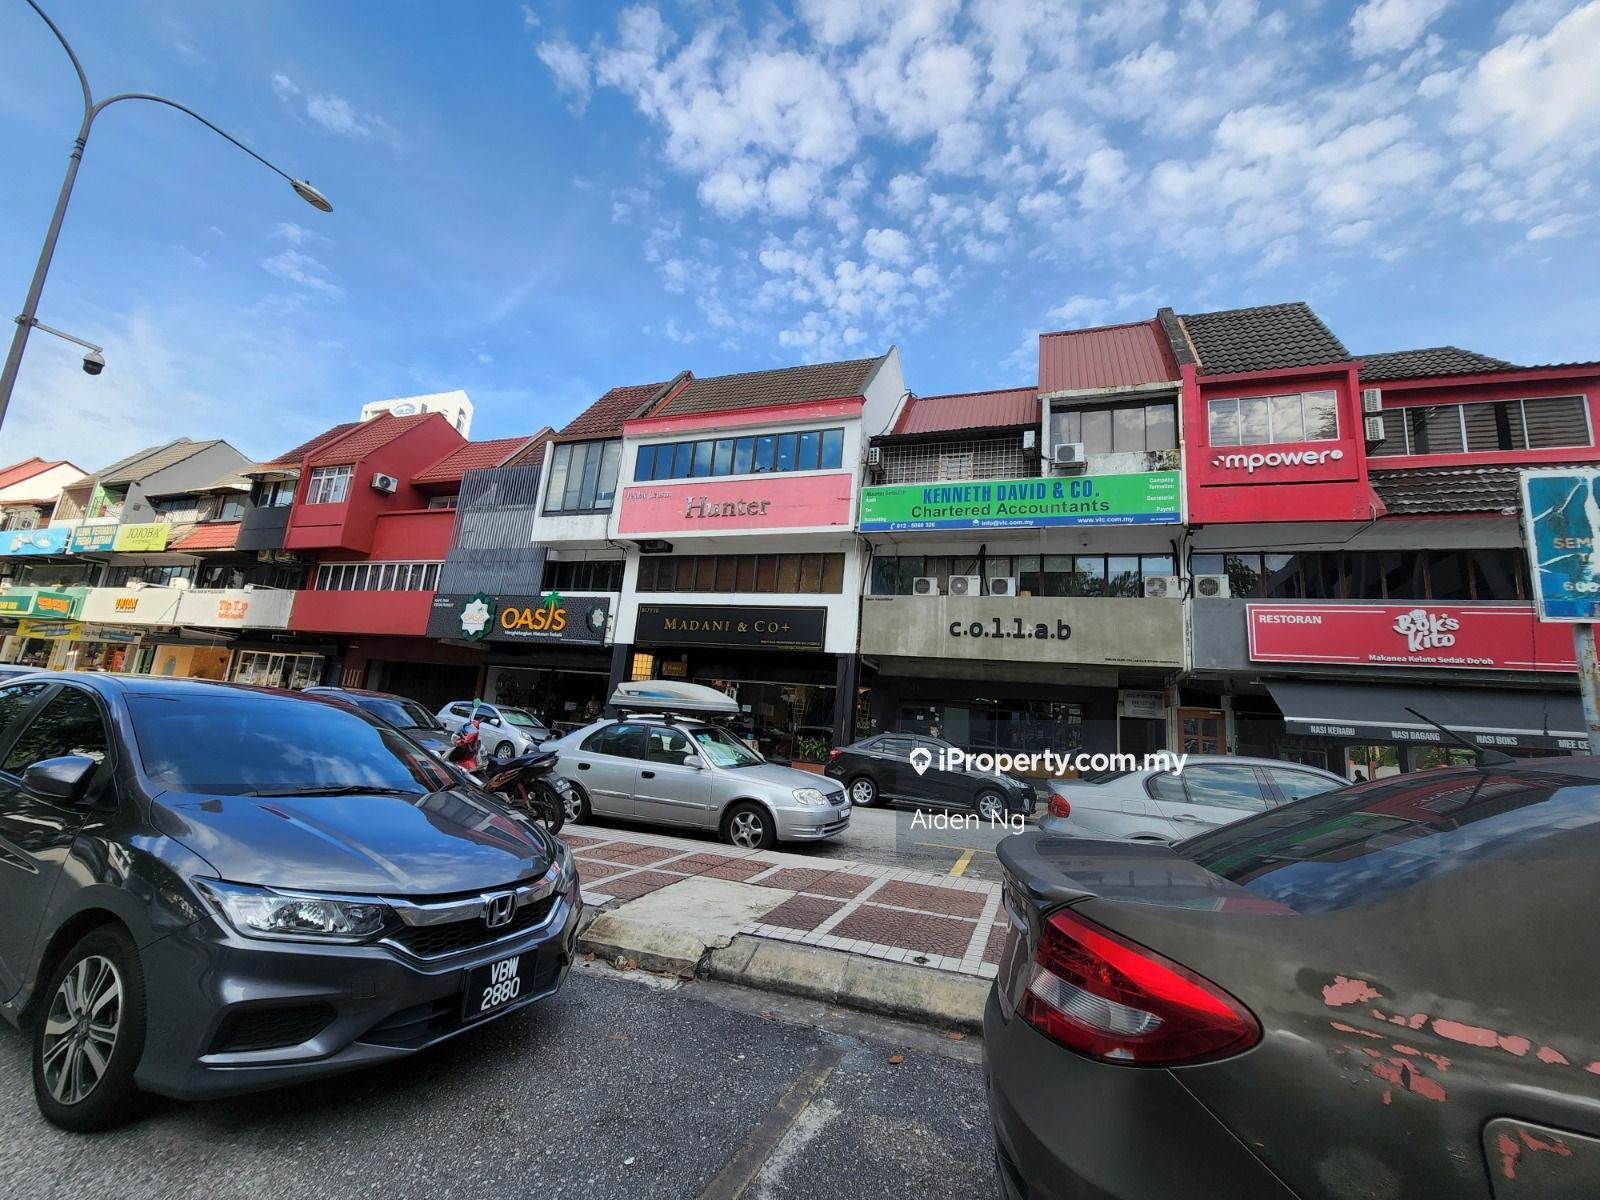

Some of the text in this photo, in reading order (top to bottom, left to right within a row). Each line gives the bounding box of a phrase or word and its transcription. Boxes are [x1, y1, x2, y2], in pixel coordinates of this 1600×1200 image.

[923, 480, 1100, 505] KENNETH DAVID & CO.
[685, 495, 771, 519] Hunter
[911, 499, 1110, 518] Chartered Accountants
[501, 600, 568, 631] OASIS
[1258, 614, 1322, 625] RESTORAN
[663, 618, 731, 632] MADANI
[737, 621, 749, 633] &
[1408, 630, 1456, 652] Kito
[1438, 656, 1466, 664] Sedak
[1310, 725, 1356, 736] NASI KERABU
[1392, 730, 1441, 741] NASI DAGANG
[1476, 735, 1518, 745] NASI BOKS
[1557, 739, 1577, 748] MEE
[491, 956, 519, 985] VBW
[481, 977, 520, 1011] 2880
